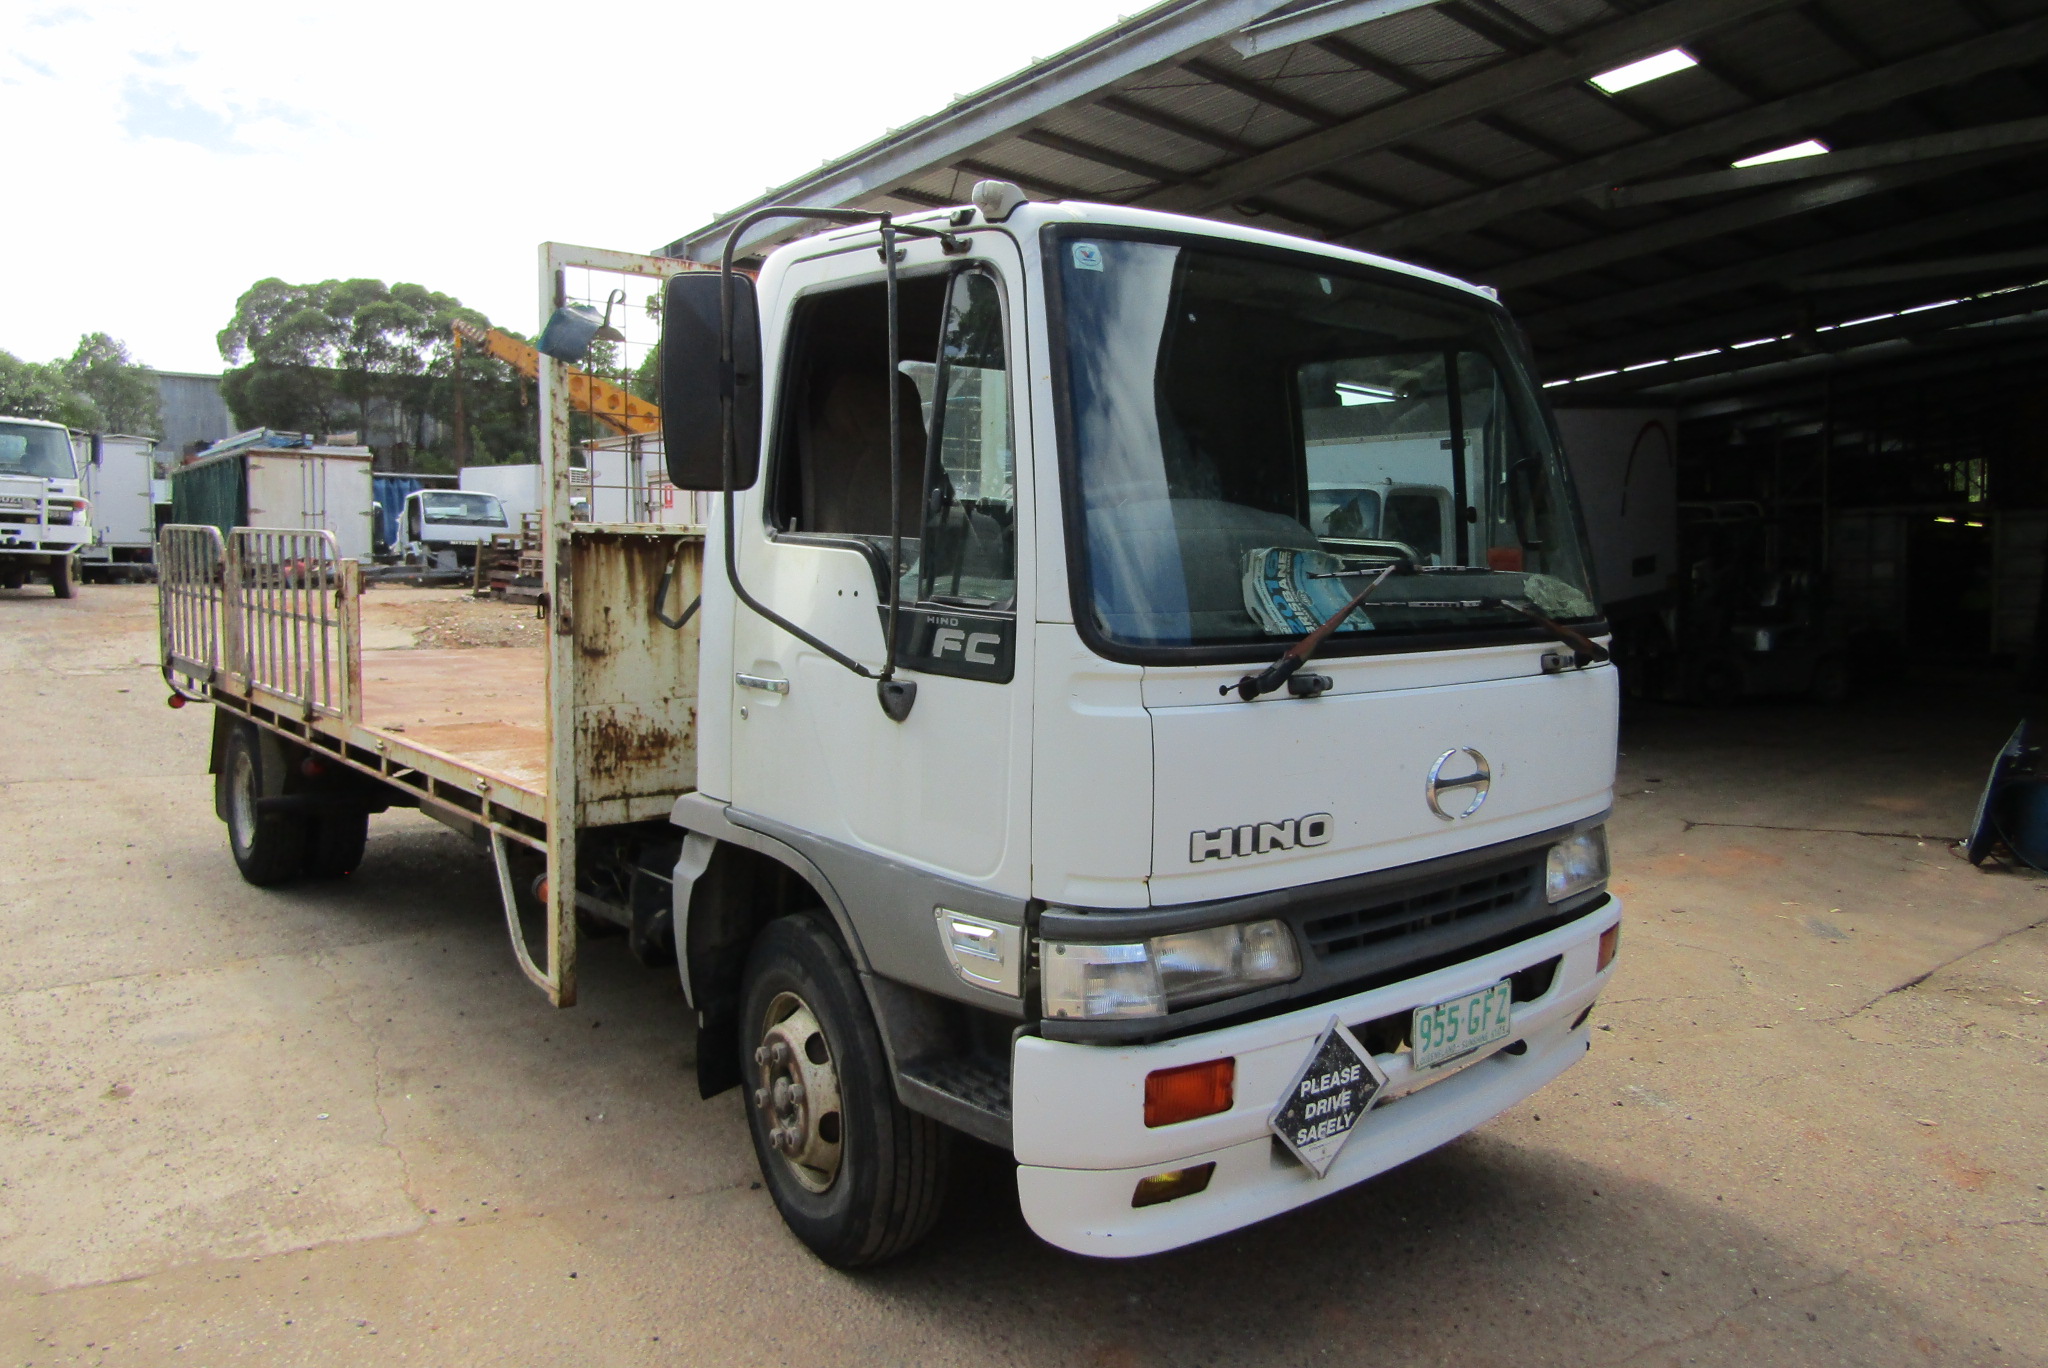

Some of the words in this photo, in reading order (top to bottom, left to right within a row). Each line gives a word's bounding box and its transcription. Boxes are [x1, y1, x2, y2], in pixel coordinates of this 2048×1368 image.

[926, 615, 959, 627] HINO
[932, 628, 1001, 665] FC
[1189, 812, 1335, 863] HINO
[1300, 1064, 1361, 1098] PLEASE
[1304, 1089, 1353, 1120] DRIVE
[1296, 1111, 1356, 1146] SAFELY
